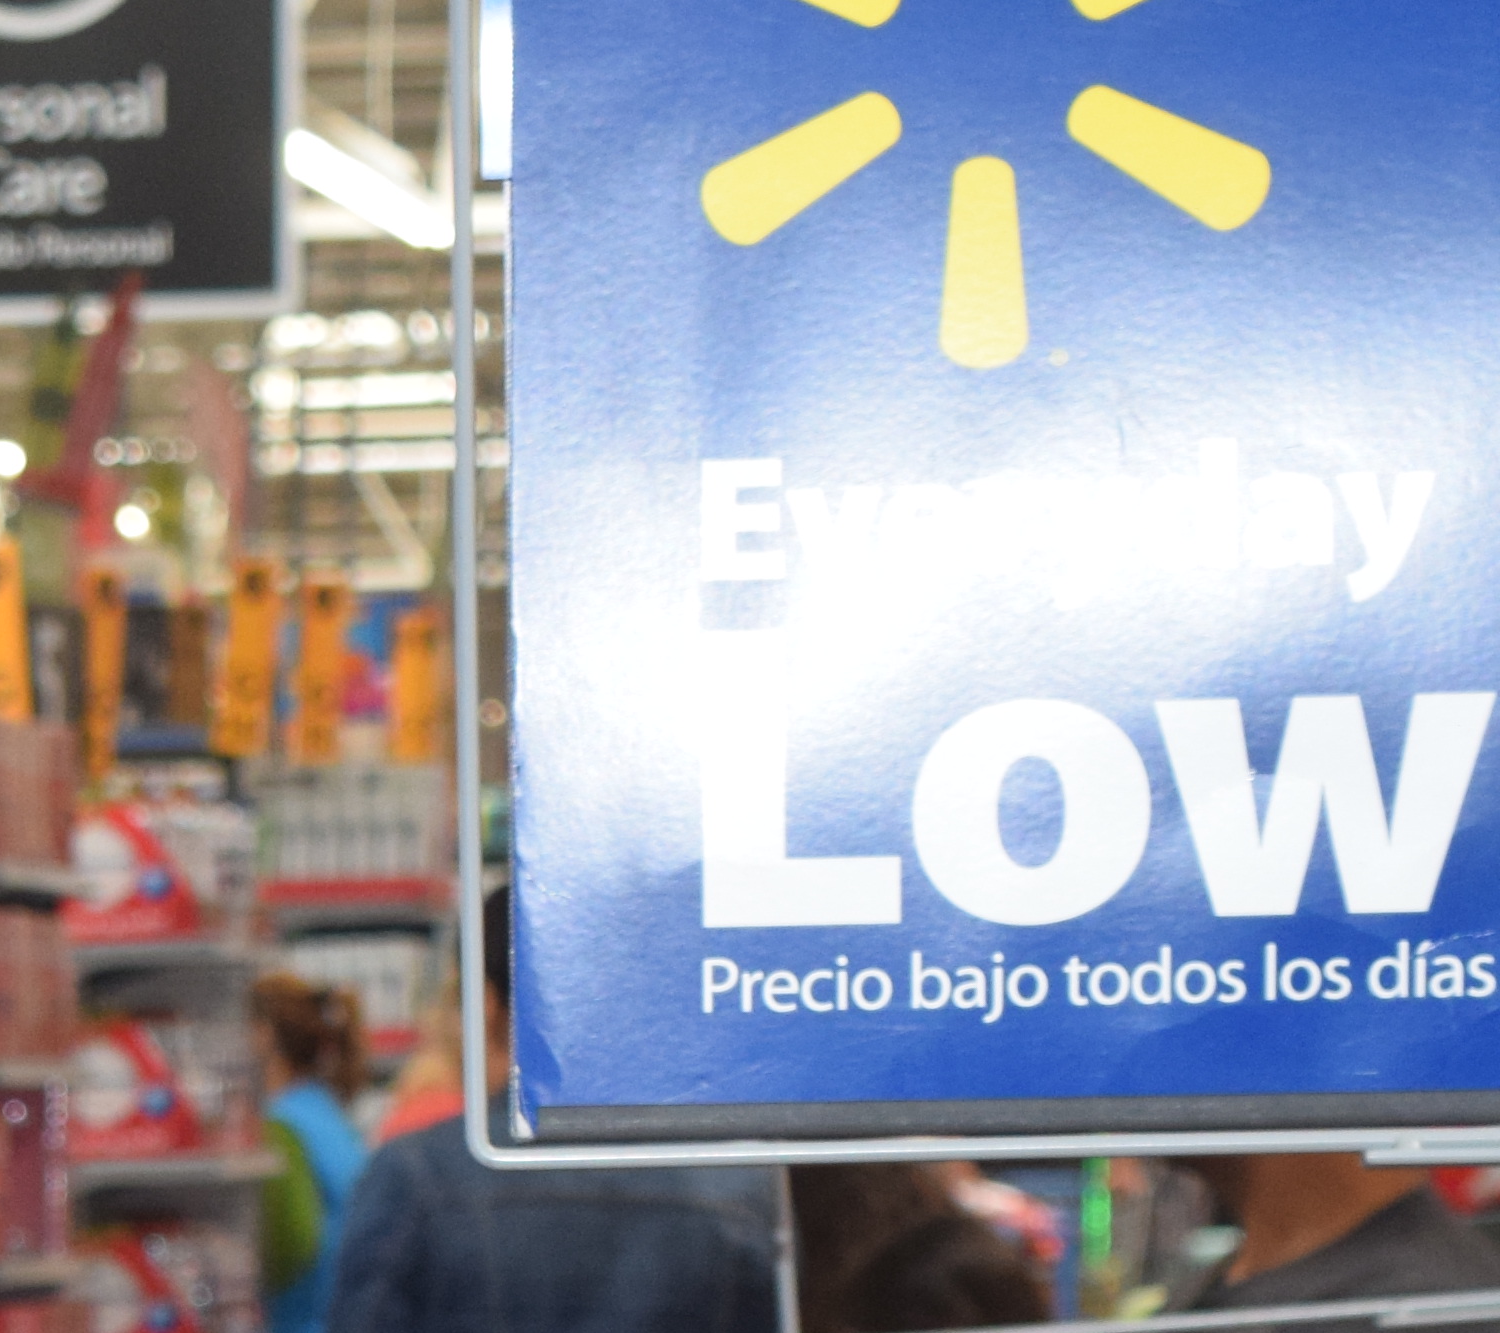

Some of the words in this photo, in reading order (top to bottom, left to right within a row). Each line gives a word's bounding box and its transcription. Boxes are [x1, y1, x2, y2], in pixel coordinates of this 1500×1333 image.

[699, 437, 1437, 611] Eveyday
[701, 956, 892, 1013] Precio
[911, 951, 1049, 1023] bajo
[1063, 946, 1246, 1006] todos
[1265, 943, 1350, 1003] los
[1368, 940, 1496, 1000] días
